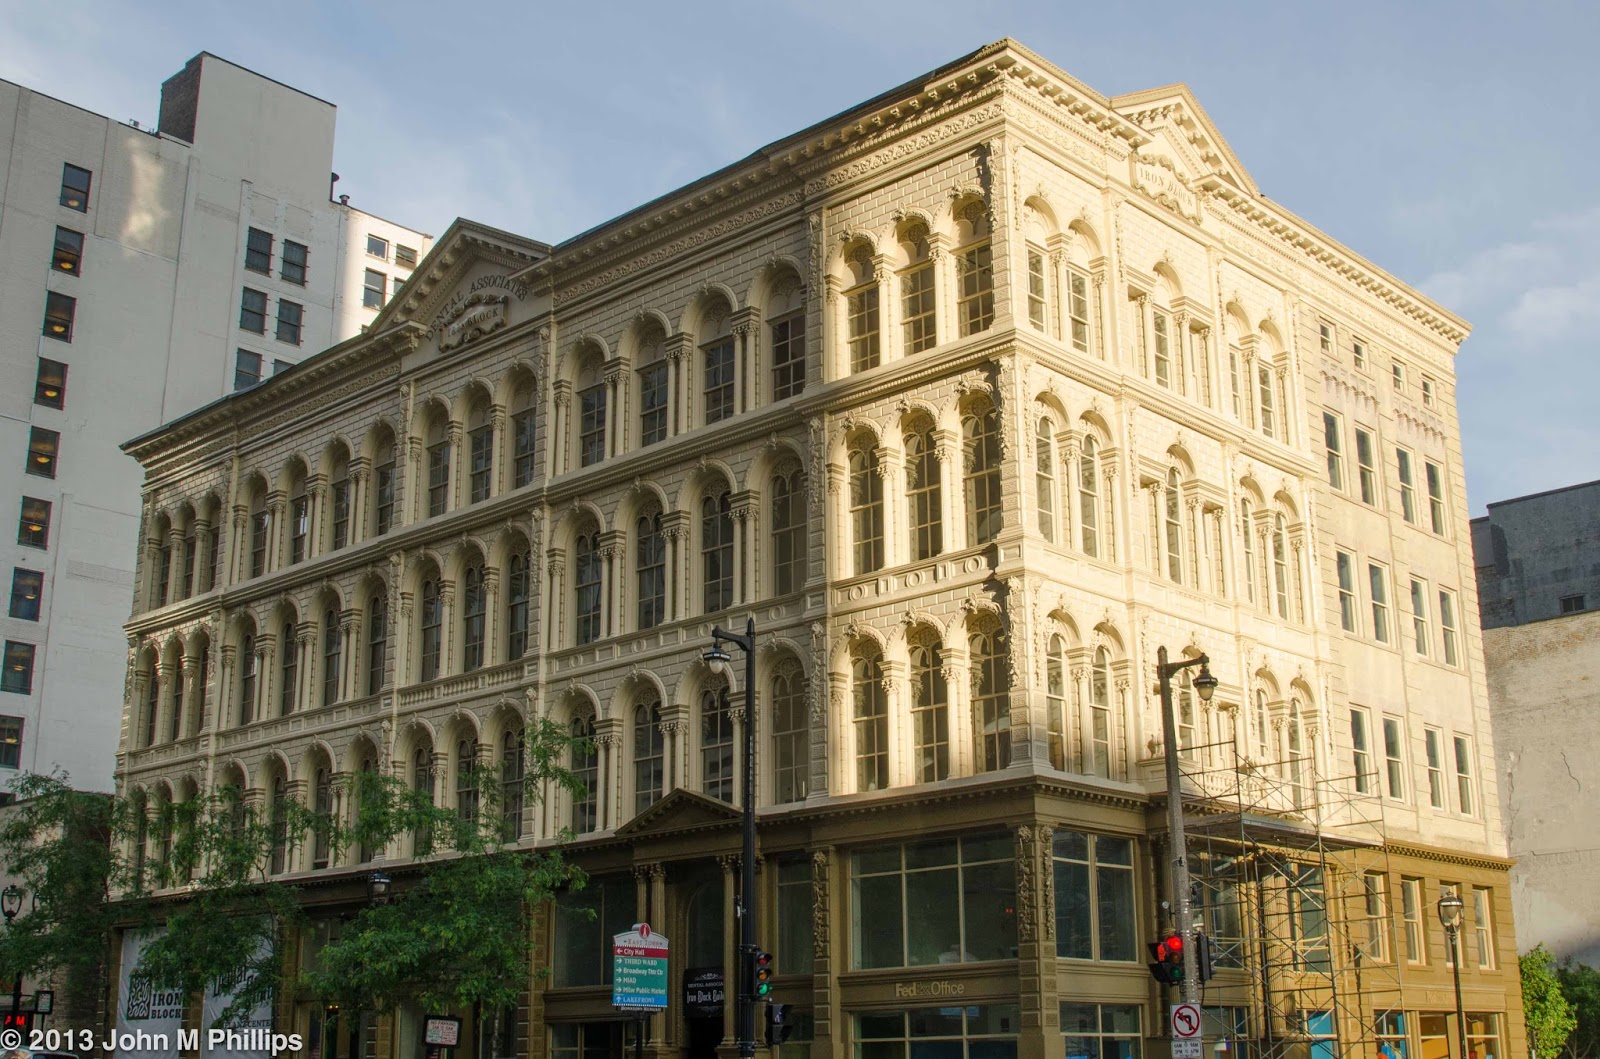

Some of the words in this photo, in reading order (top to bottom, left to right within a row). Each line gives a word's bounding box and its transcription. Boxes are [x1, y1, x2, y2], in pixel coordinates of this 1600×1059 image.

[1140, 168, 1164, 187] IRON
[1167, 182, 1193, 207] BLOCK
[425, 291, 465, 342] DENTAL
[469, 275, 528, 301] ASSOCIATES
[467, 308, 498, 327] BLOCK
[623, 948, 634, 956] City
[623, 967, 647, 976] Broadway
[895, 982, 931, 997] FedEx
[931, 981, 965, 996] Office
[152, 992, 183, 1006] IRON
[687, 991, 697, 1003] Iron
[698, 990, 712, 1003] Block
[151, 1008, 182, 1019] BLOCK
